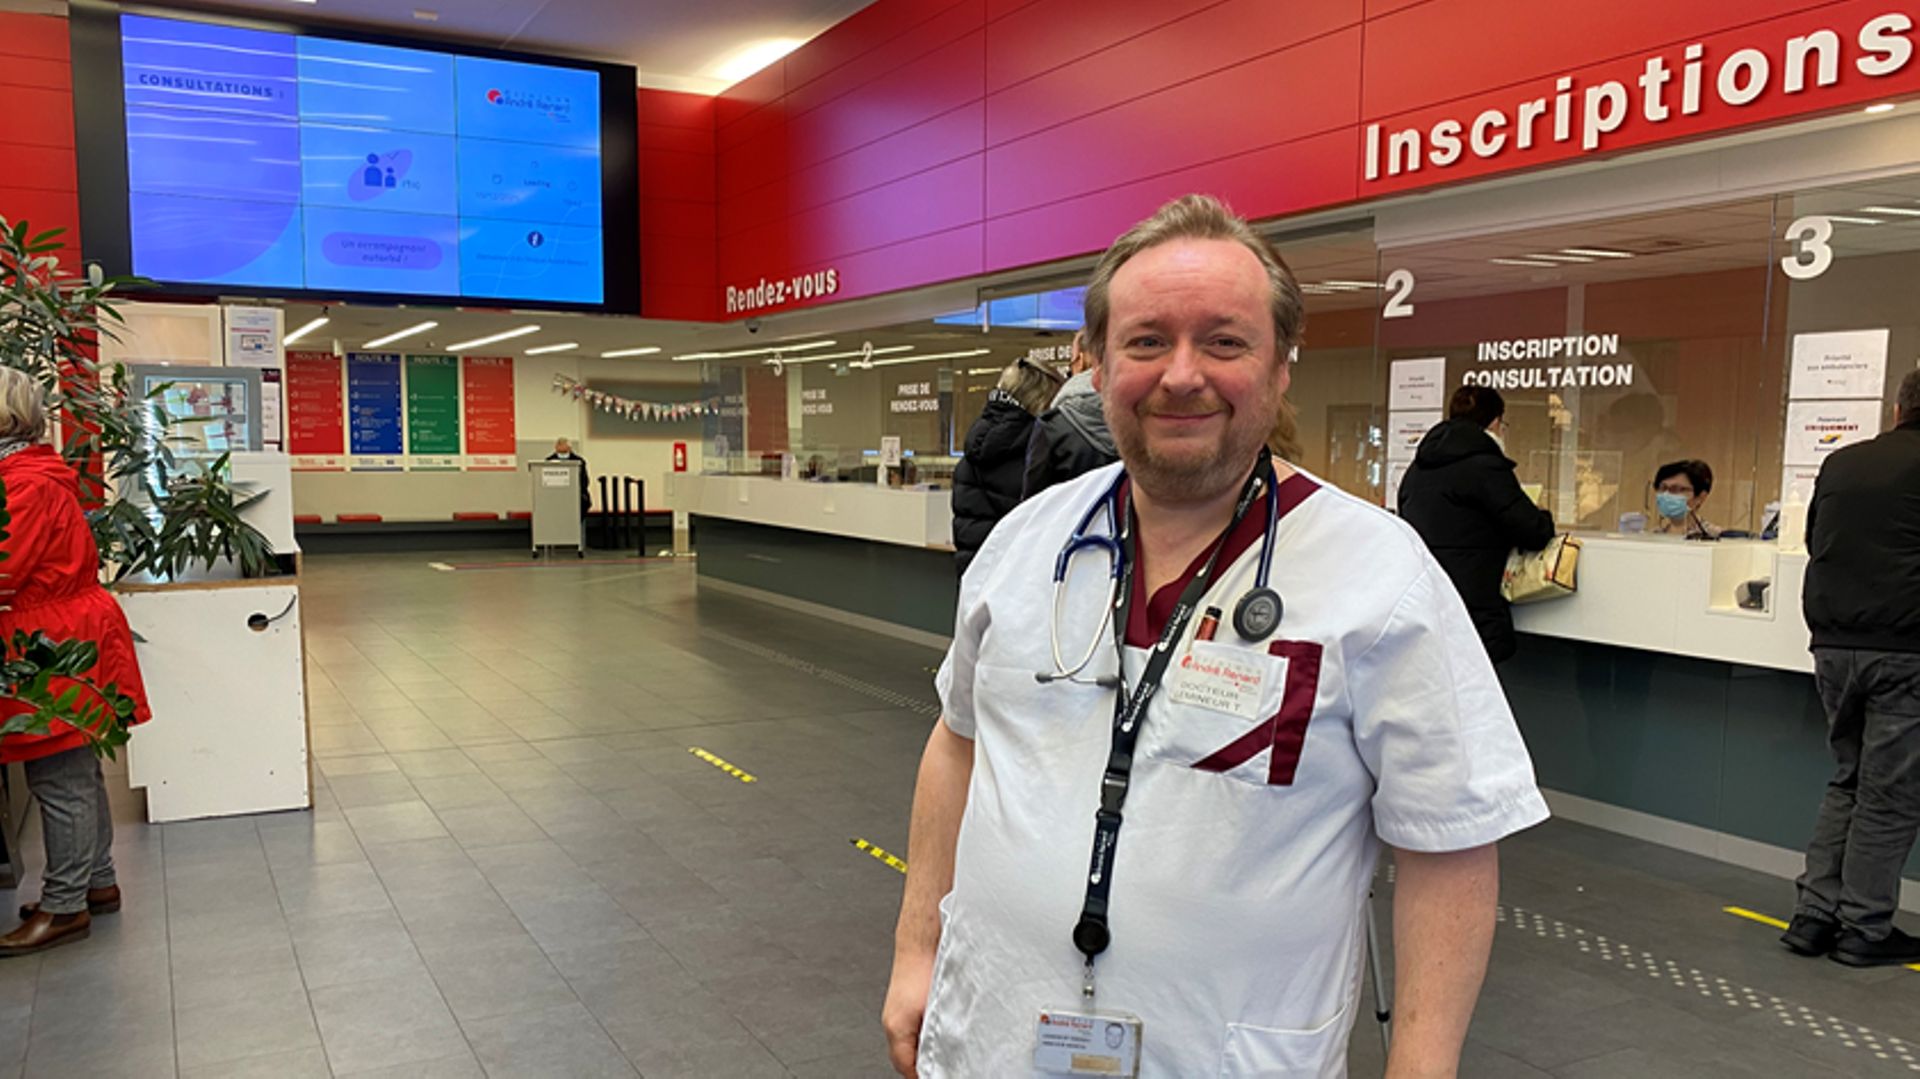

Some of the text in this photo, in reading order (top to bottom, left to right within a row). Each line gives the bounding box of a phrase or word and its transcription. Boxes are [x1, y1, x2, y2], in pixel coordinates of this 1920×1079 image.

[139, 73, 273, 97] CONSULTATIONS
[1364, 13, 1914, 180] Inscriptions
[1781, 216, 1834, 279] 3
[726, 268, 837, 314] Rendez-vous
[1382, 269, 1415, 318] 2
[1478, 334, 1620, 362] INSCRIPTION
[1462, 364, 1633, 389] CONSULTATION
[1181, 681, 1239, 699] DOCTEUR
